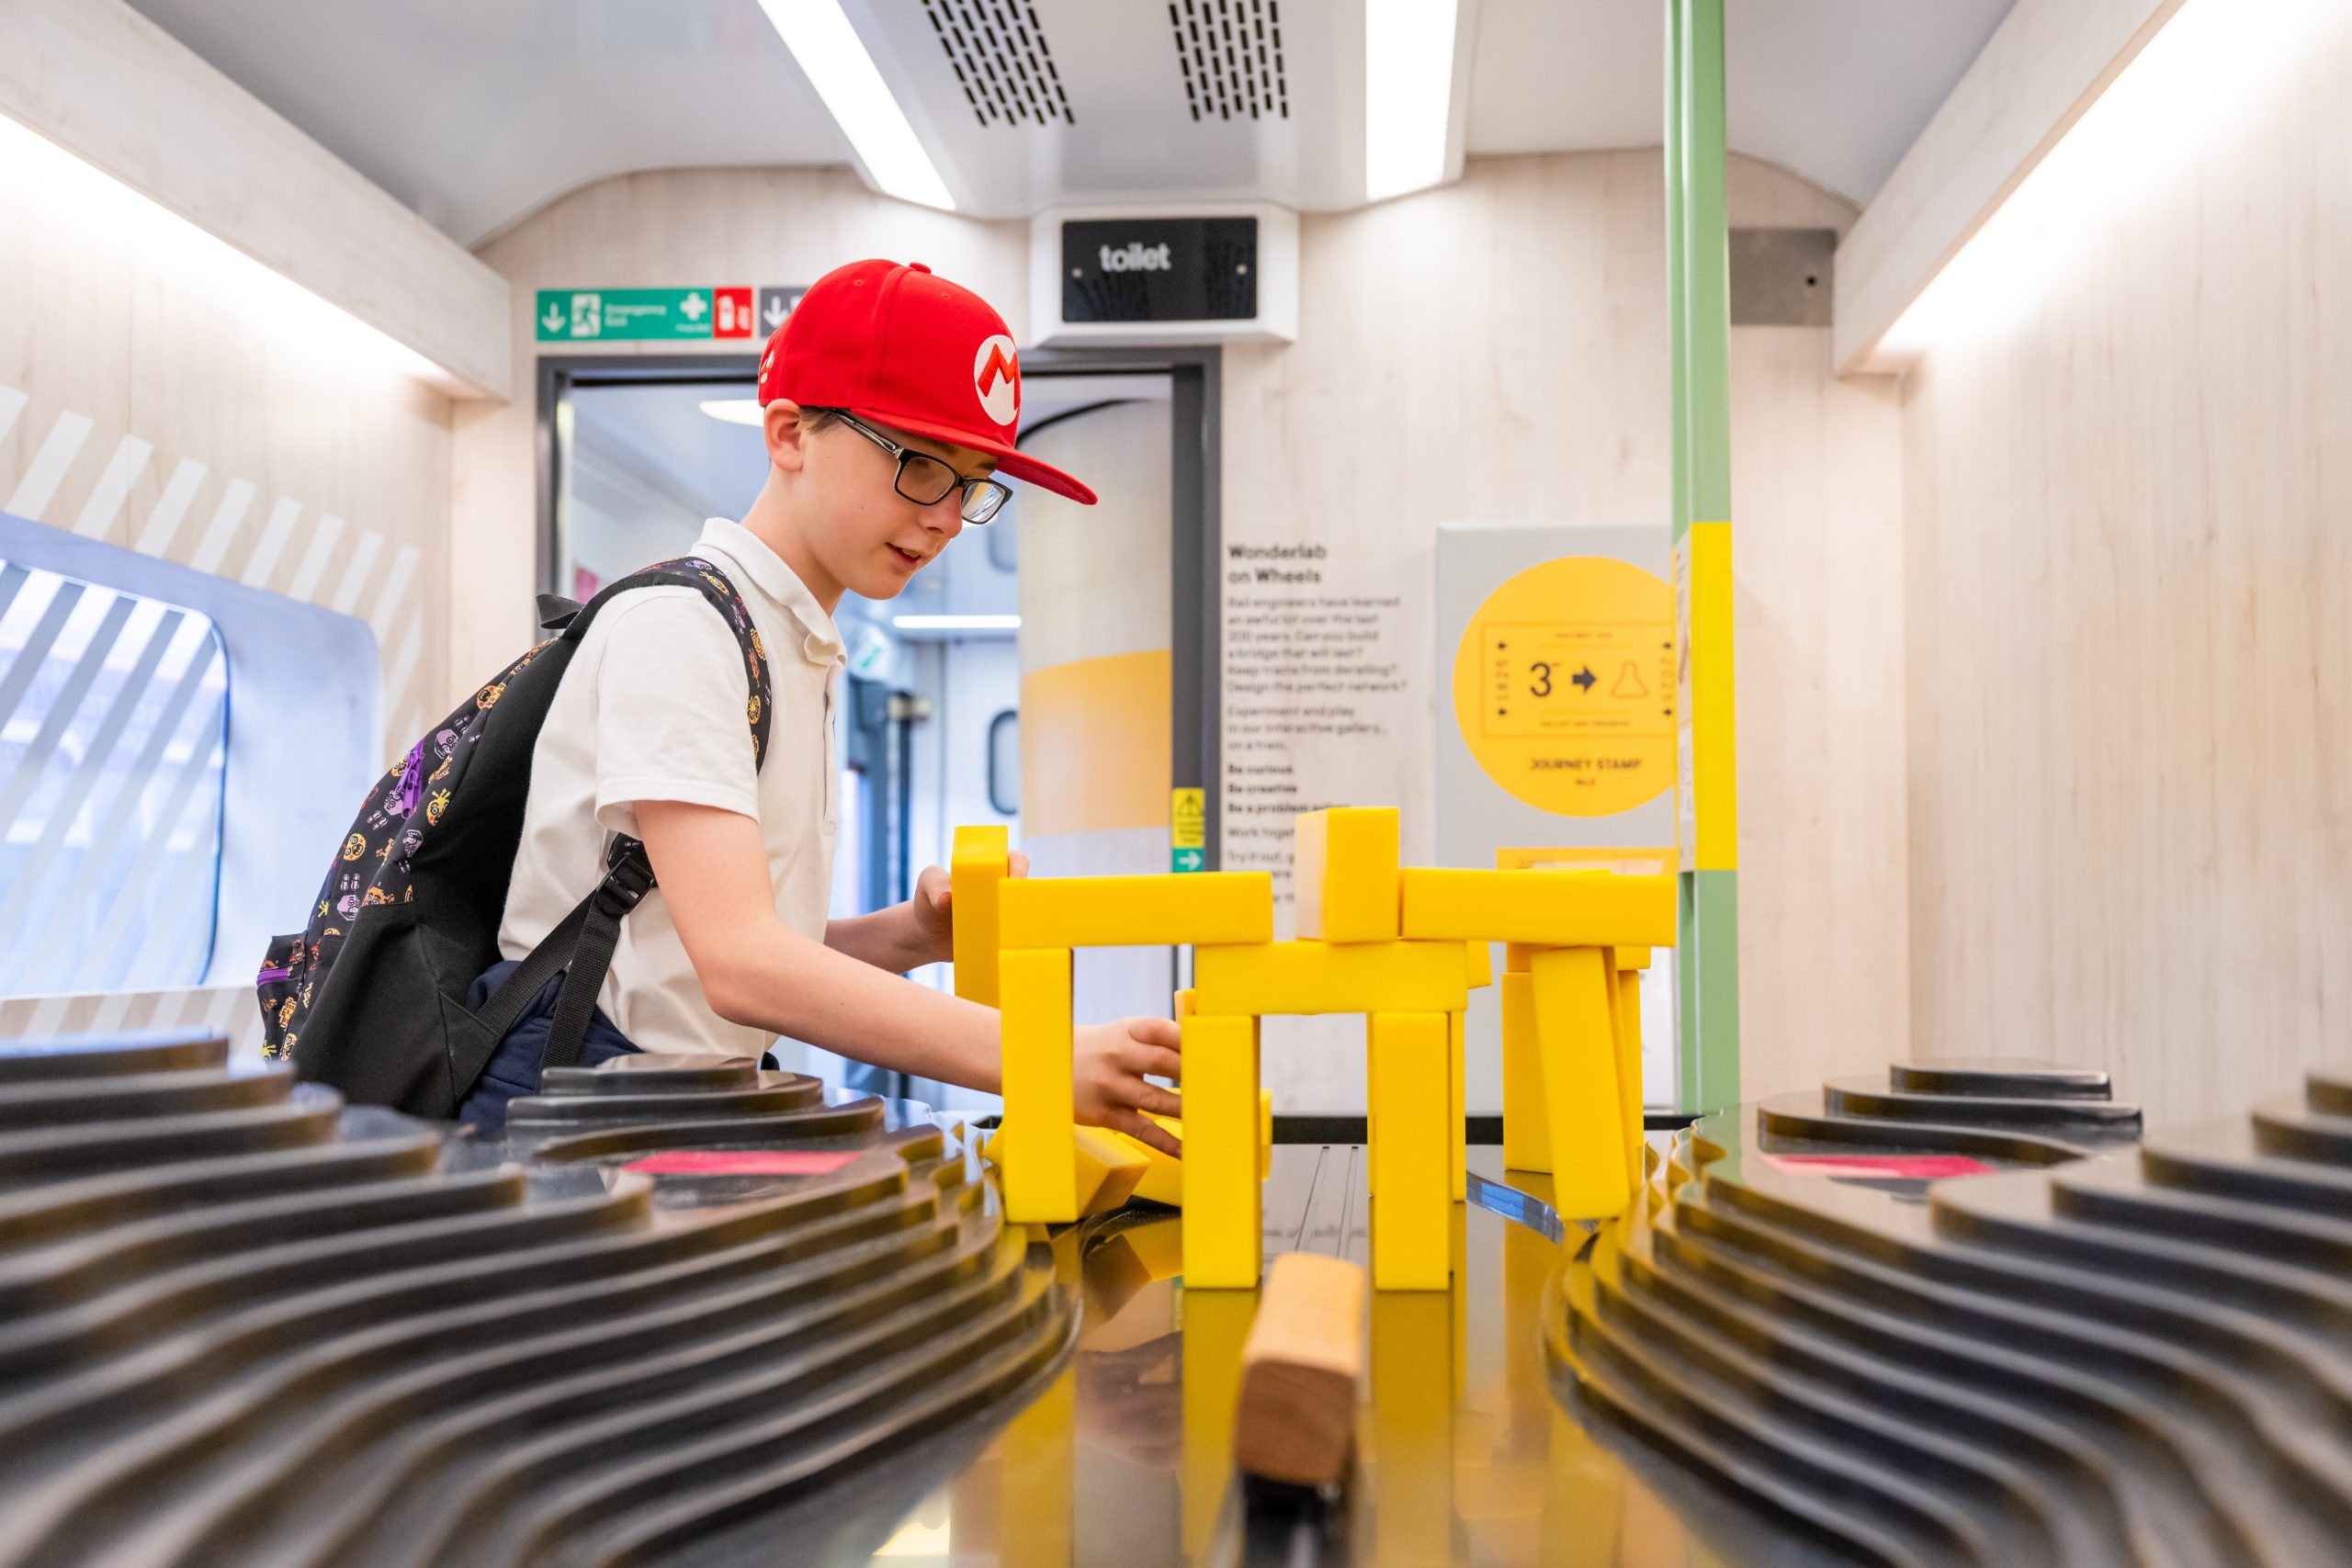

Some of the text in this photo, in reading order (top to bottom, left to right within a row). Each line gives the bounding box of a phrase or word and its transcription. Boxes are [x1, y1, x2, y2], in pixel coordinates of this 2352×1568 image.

[1099, 243, 1172, 272] toilet
[978, 344, 1020, 410] M
[1228, 545, 1327, 559] Wonderlab
[1228, 569, 1321, 582] on Wheels
[1254, 598, 1315, 609] engineers
[1319, 598, 1347, 609] have
[1352, 598, 1400, 609] learned
[1228, 615, 1240, 625] an
[1247, 615, 1277, 625] awful
[1303, 615, 1328, 625] over
[1333, 615, 1351, 625] the
[1296, 631, 1317, 642] Can
[1323, 631, 1342, 642] you
[1348, 631, 1379, 642] build
[1239, 648, 1277, 659] bridge
[1282, 648, 1306, 659] that
[1311, 648, 1329, 659] will
[1227, 664, 1258, 676] Keep
[1302, 664, 1329, 676] from
[1227, 681, 1269, 694] Design
[1273, 681, 1293, 694] the
[1296, 681, 1344, 694] perfect
[1228, 705, 1354, 716] Experiment and play
[1266, 722, 1332, 734] interactive
[1228, 764, 1293, 773] Be curious
[1531, 759, 1641, 771] JOURNEY STAMP
[1228, 784, 1297, 794] Be creative
[1228, 802, 1241, 814] Be
[1257, 802, 1307, 814] problem
[1228, 828, 1295, 839] Work toget
